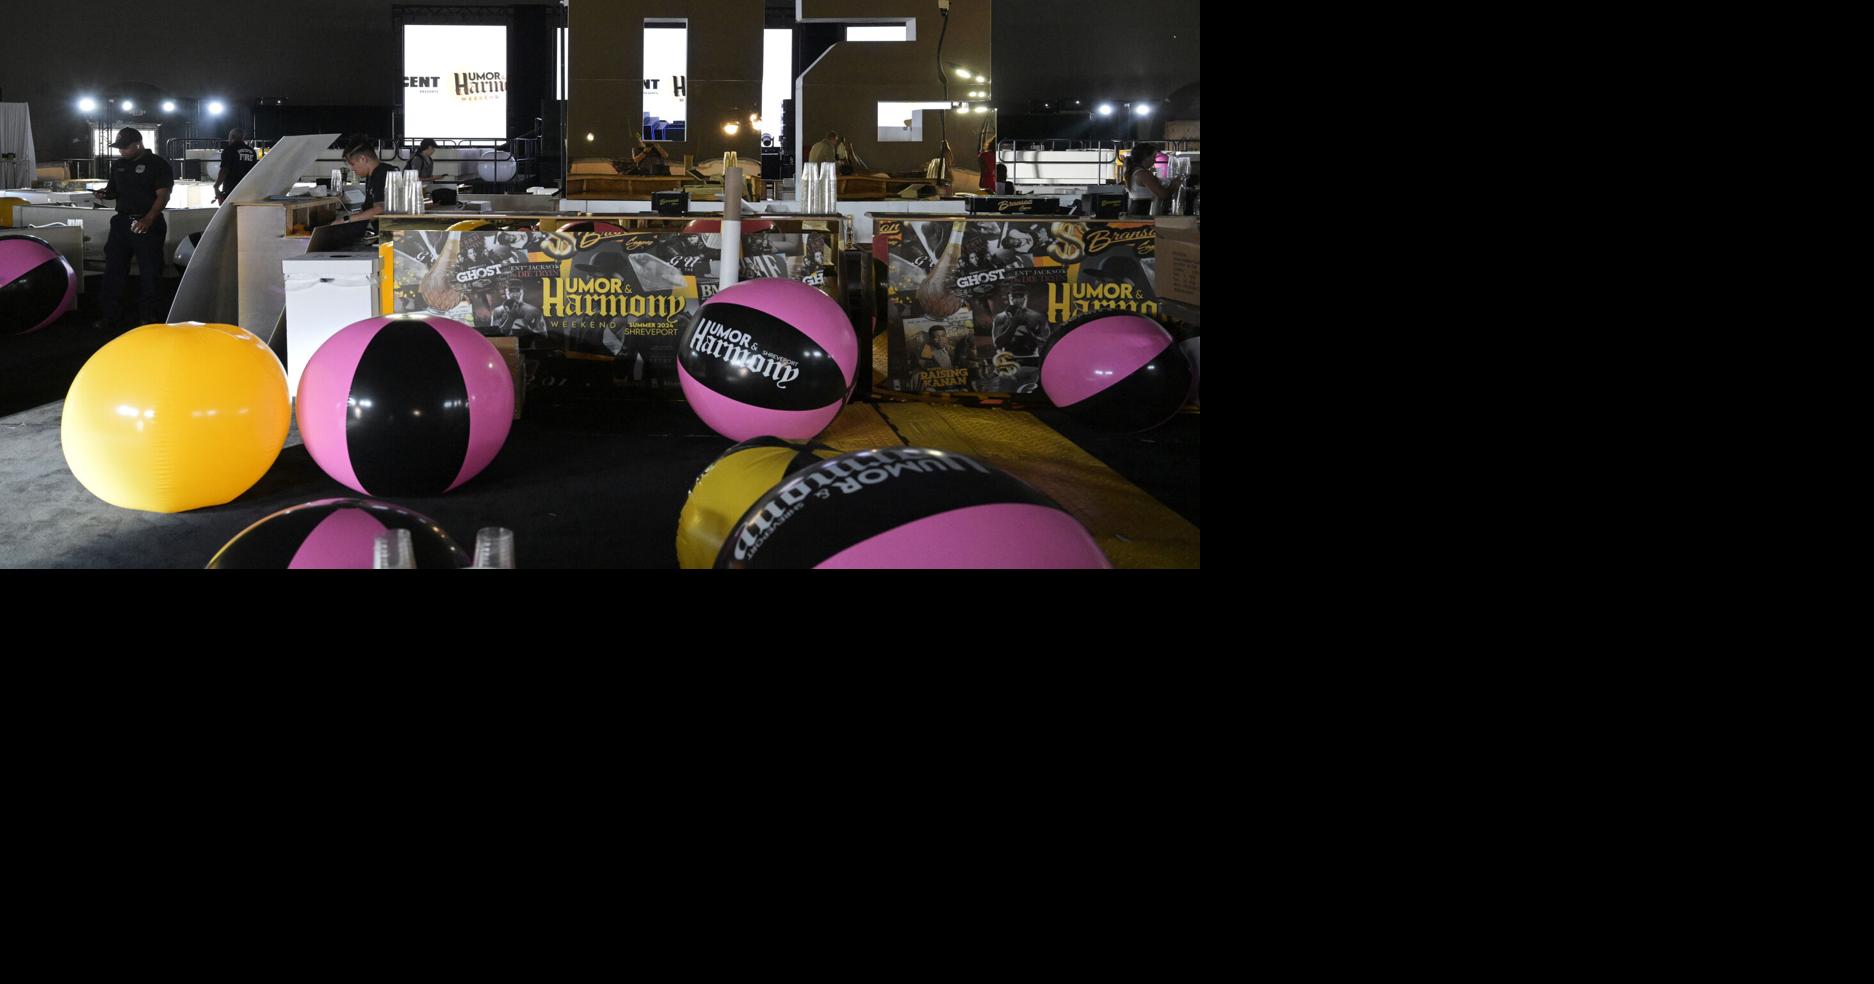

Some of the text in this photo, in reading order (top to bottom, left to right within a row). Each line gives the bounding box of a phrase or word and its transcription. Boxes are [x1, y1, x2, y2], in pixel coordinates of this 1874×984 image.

[239, 153, 254, 162] FIRE
[456, 263, 503, 283] GHOST
[956, 268, 1005, 289] GHOST
[543, 277, 633, 297] HUMOR &
[1047, 282, 1144, 303] HUMOR &
[543, 278, 686, 323] Harmony
[551, 321, 617, 329] WEEKEND
[624, 328, 679, 336] SHREVEPORT
[696, 317, 759, 351] HUMOR &
[690, 317, 800, 389] Harmony
[920, 367, 969, 380] RAISING
